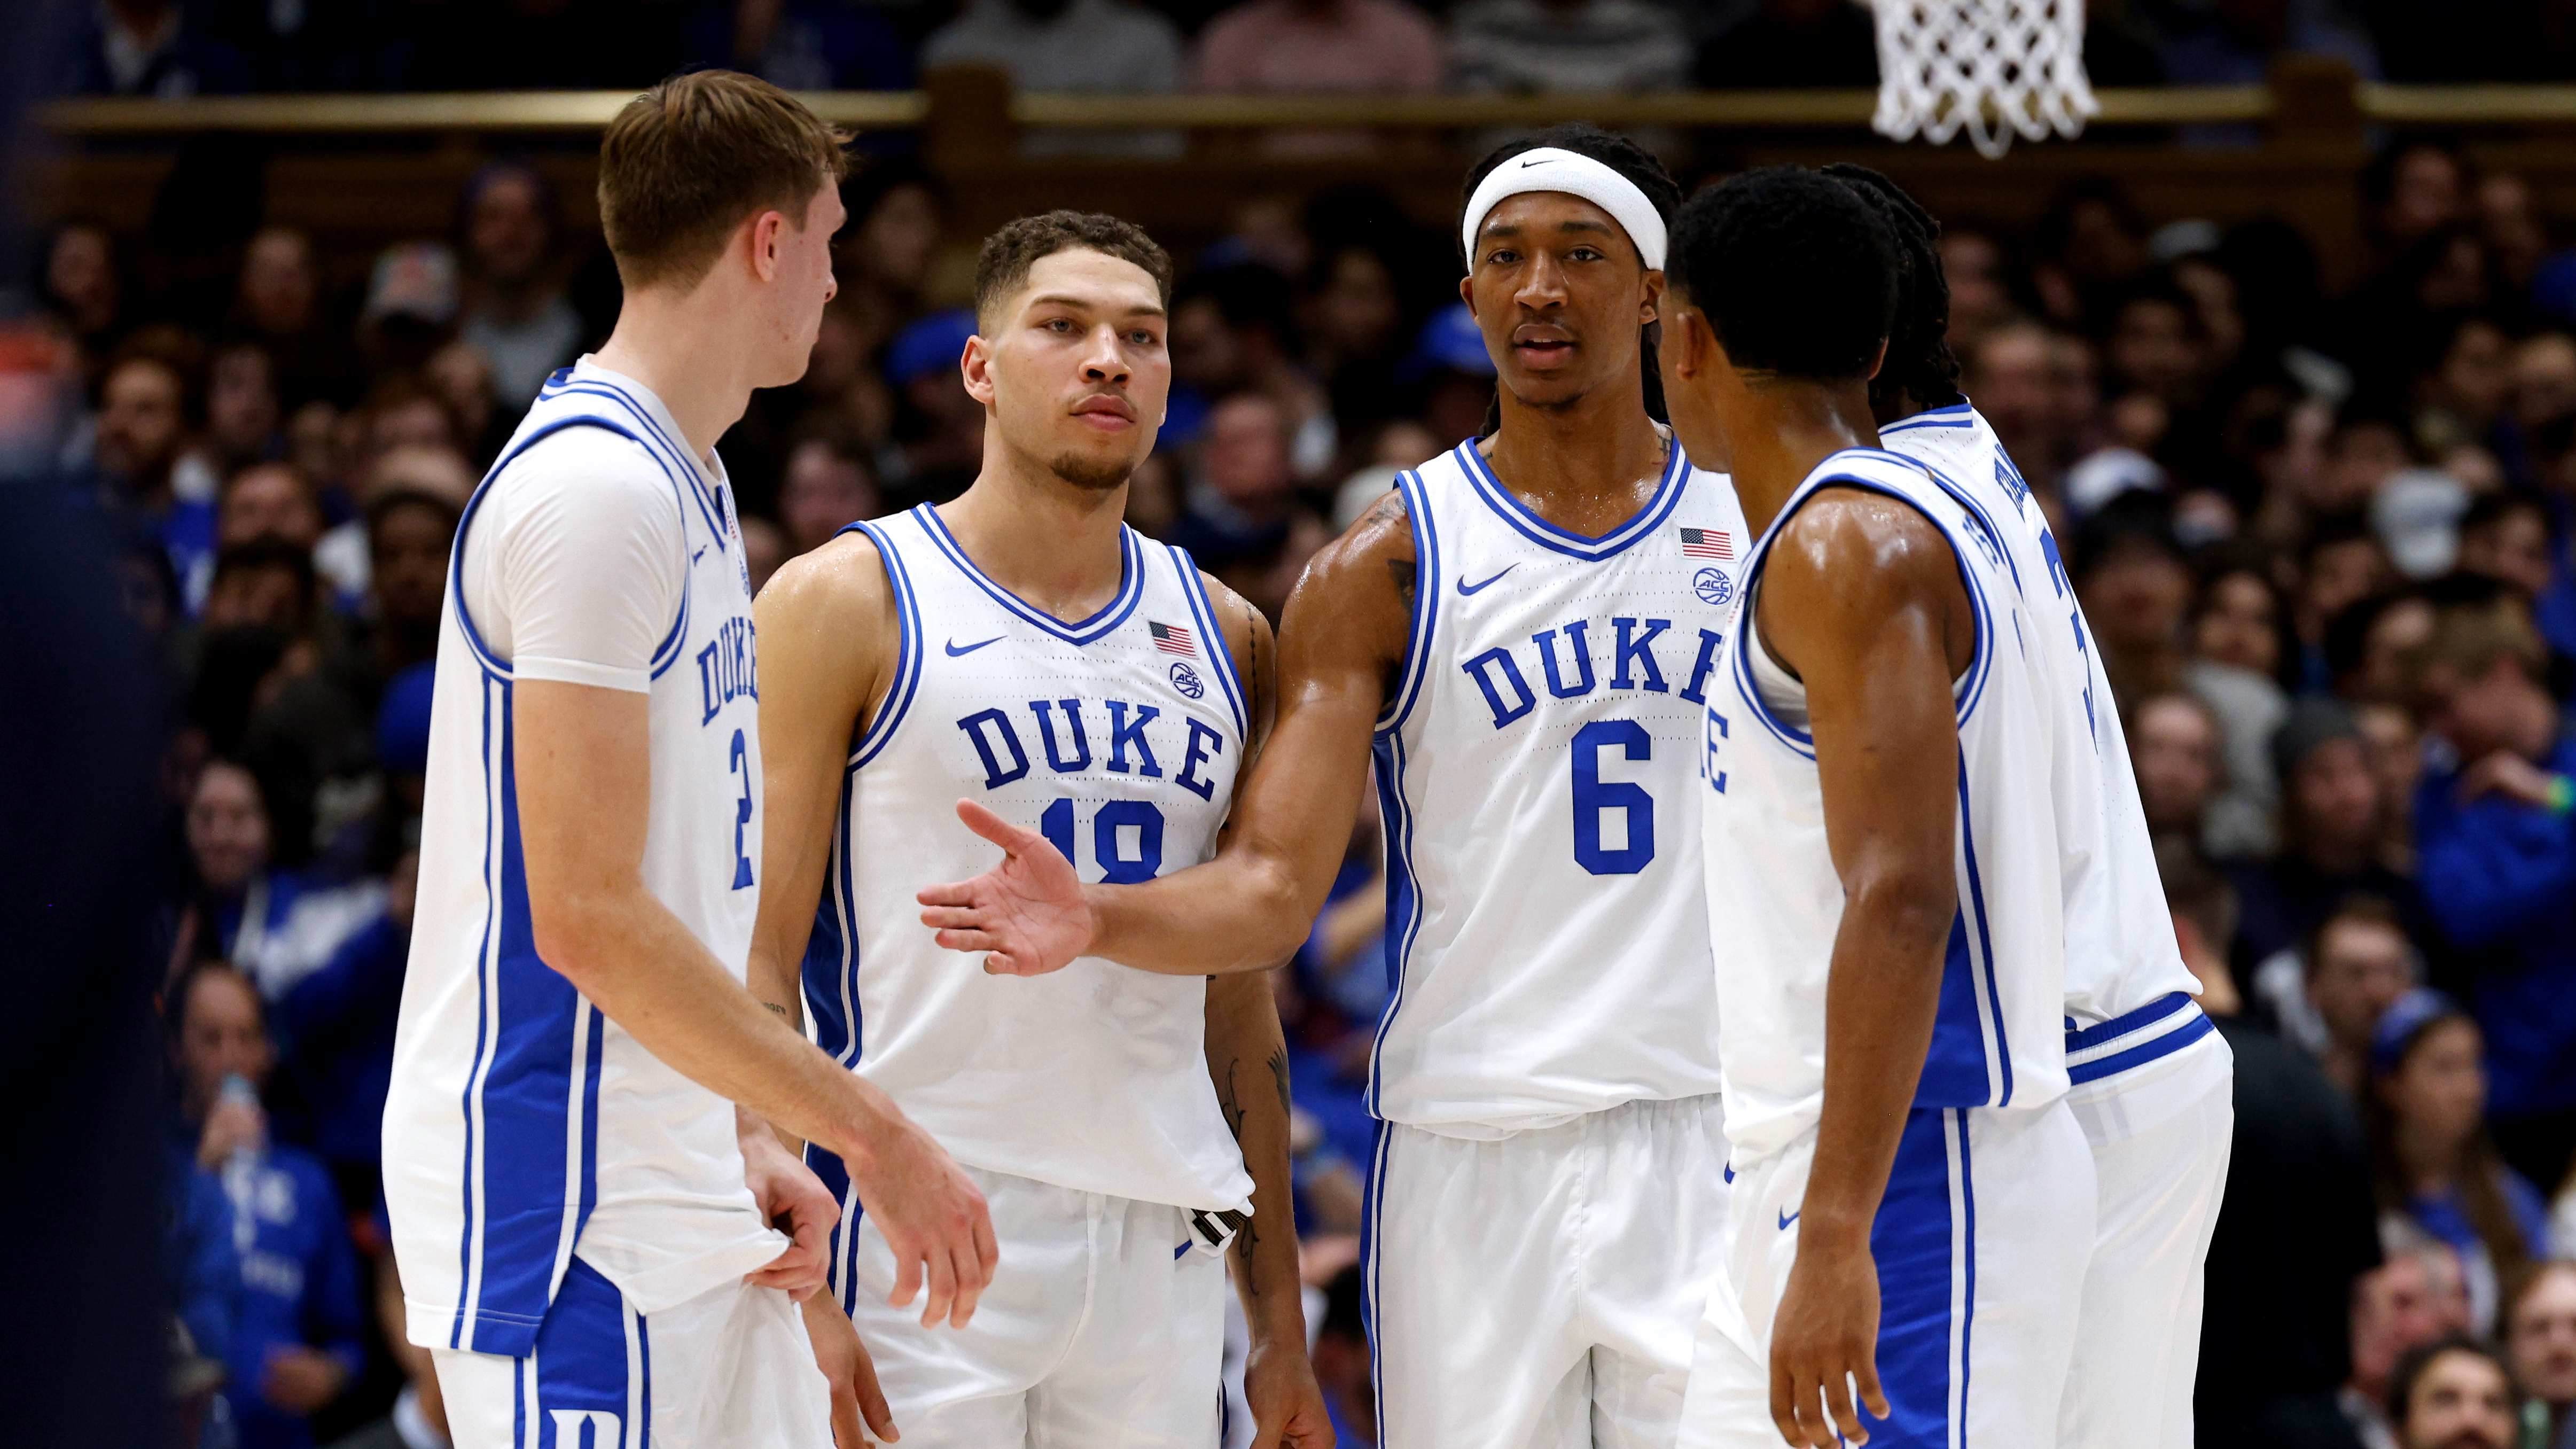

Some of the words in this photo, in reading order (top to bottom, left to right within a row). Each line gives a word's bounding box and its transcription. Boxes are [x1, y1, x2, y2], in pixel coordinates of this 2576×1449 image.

[1699, 580, 1729, 591] ACC
[697, 617, 759, 727] DUKE
[1176, 674, 1199, 687] ACC
[956, 698, 1223, 802] DUKE
[1571, 720, 1654, 875] 6
[730, 728, 754, 891] 2
